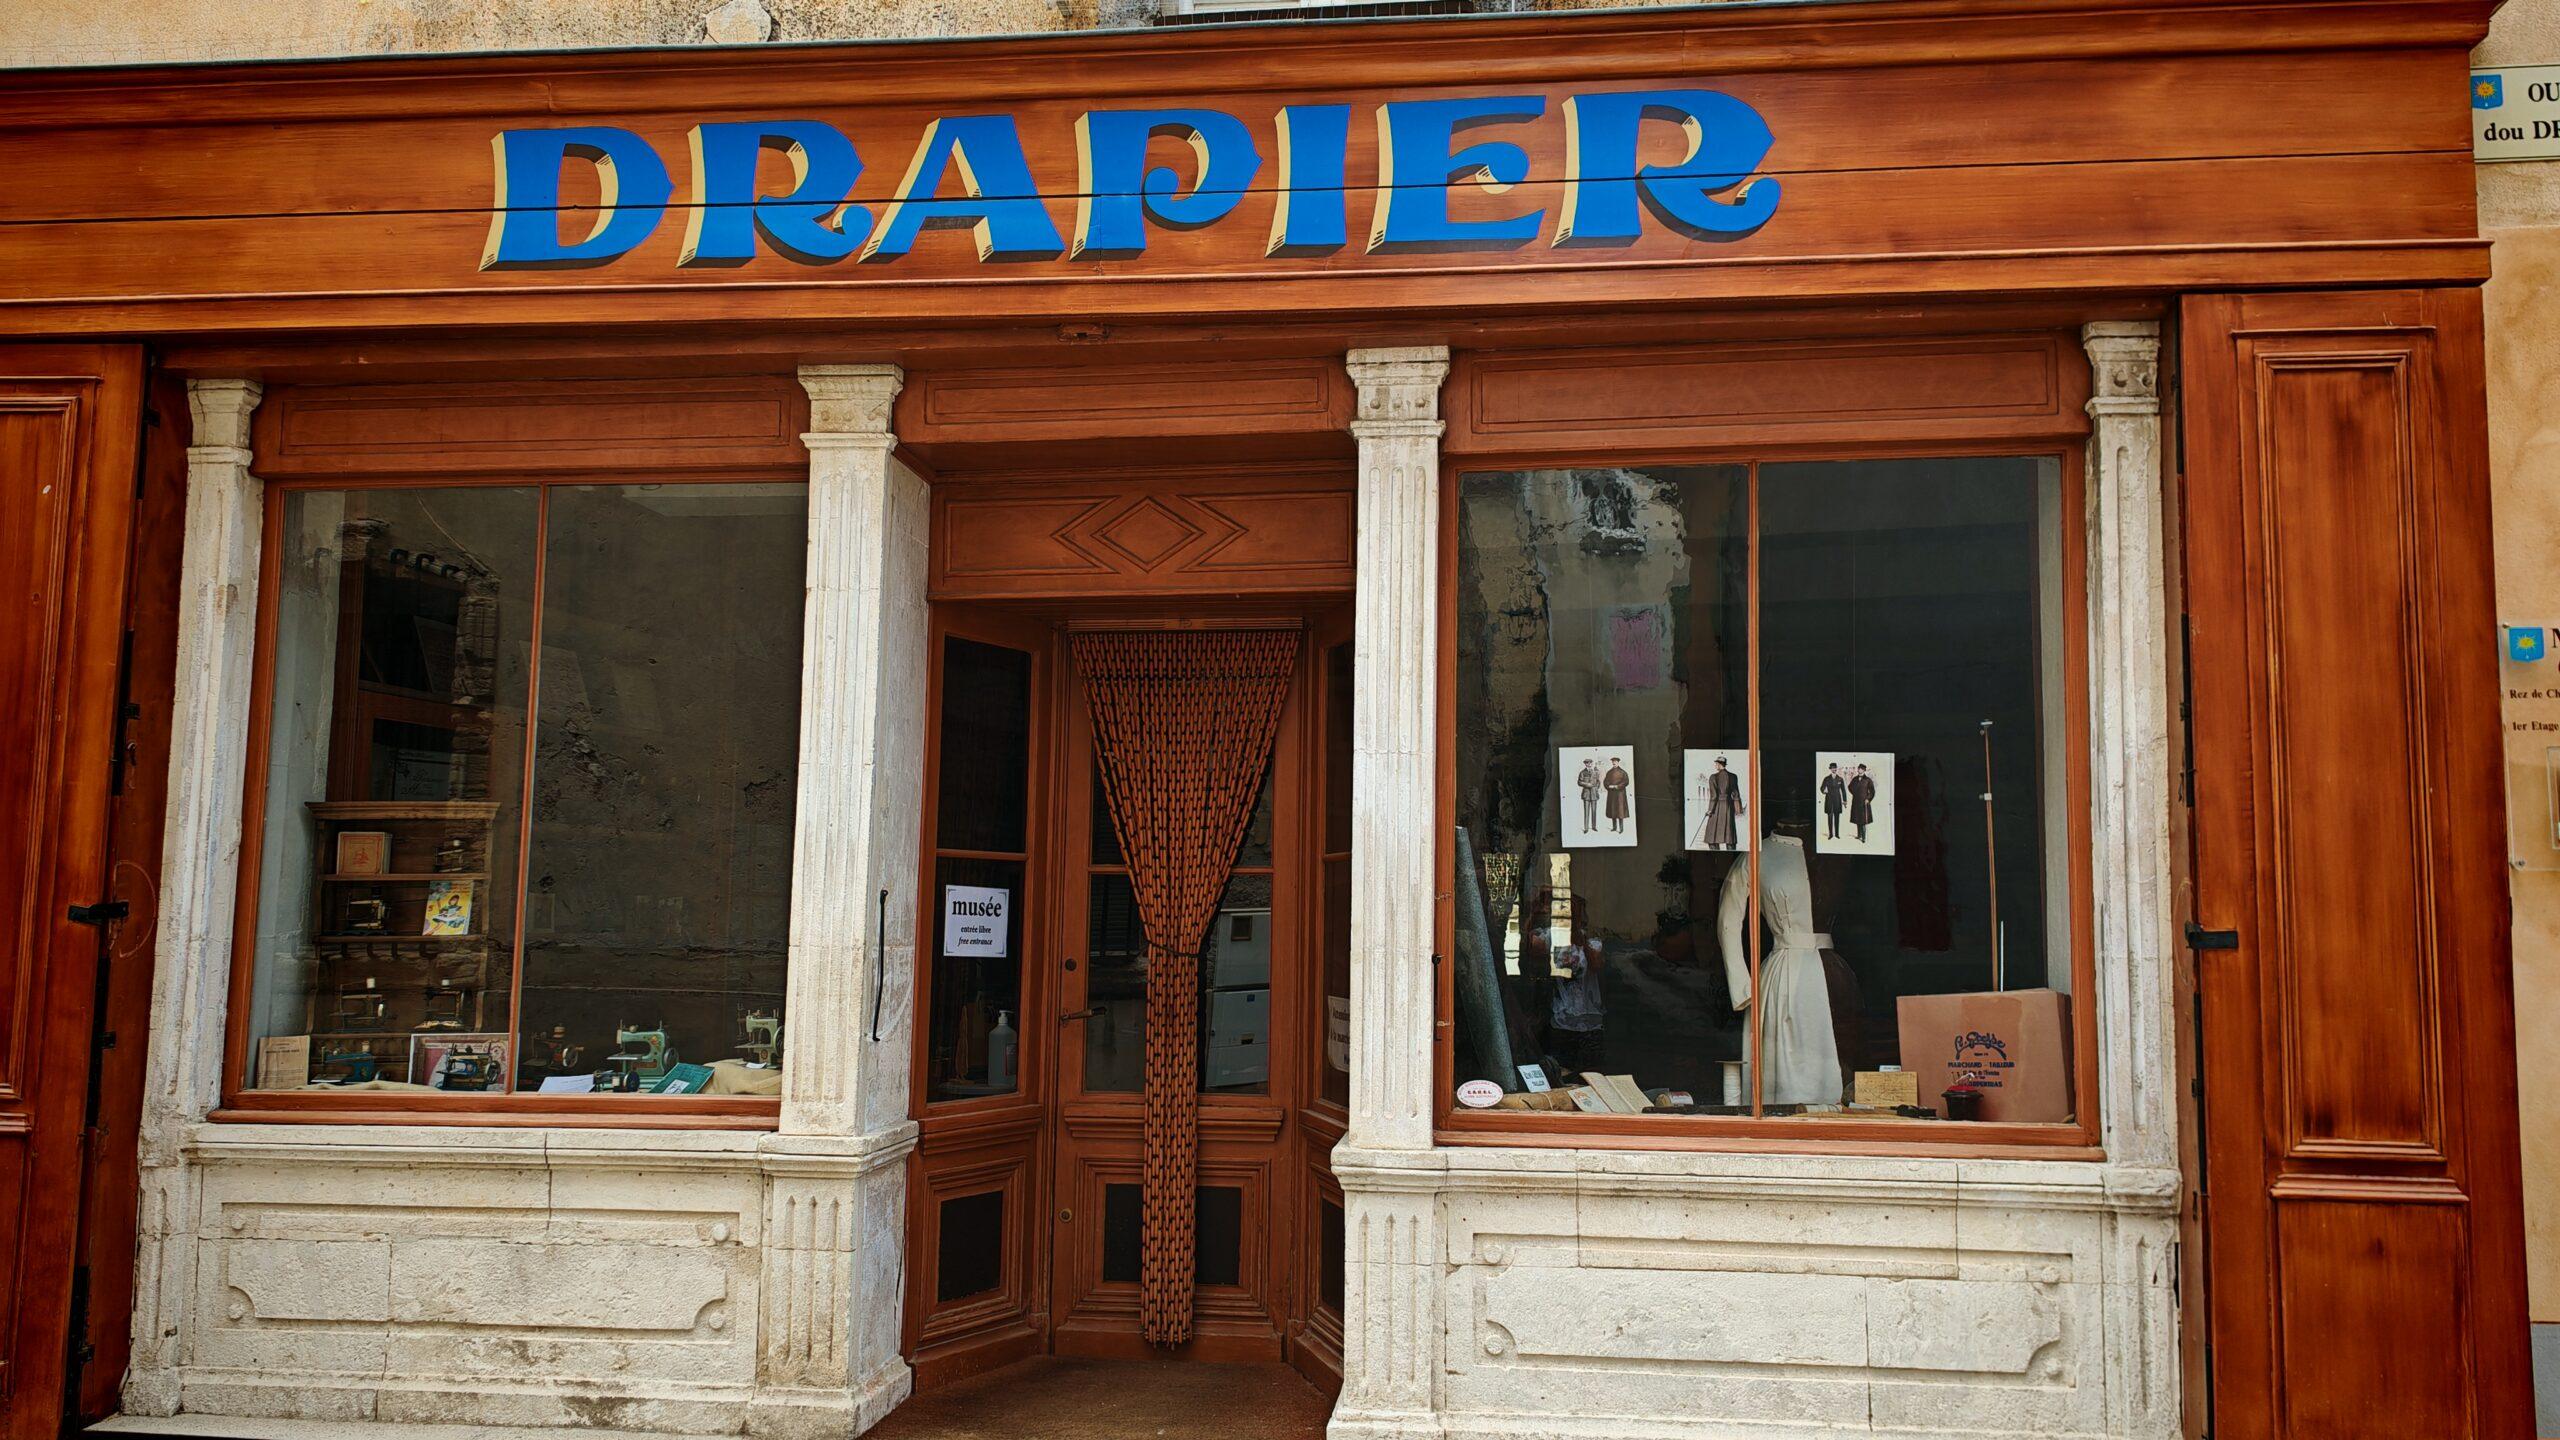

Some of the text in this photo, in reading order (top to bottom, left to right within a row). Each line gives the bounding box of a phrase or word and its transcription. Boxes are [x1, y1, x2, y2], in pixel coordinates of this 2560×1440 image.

[2484, 122, 2524, 141] dou
[479, 89, 1781, 272] DRAPIER
[2510, 689, 2527, 699] Rez
[2531, 689, 2542, 699] de
[2532, 721, 2559, 732] Etage
[952, 896, 1002, 918] musée
[961, 925, 992, 934] entrée libre
[957, 937, 969, 947] free
